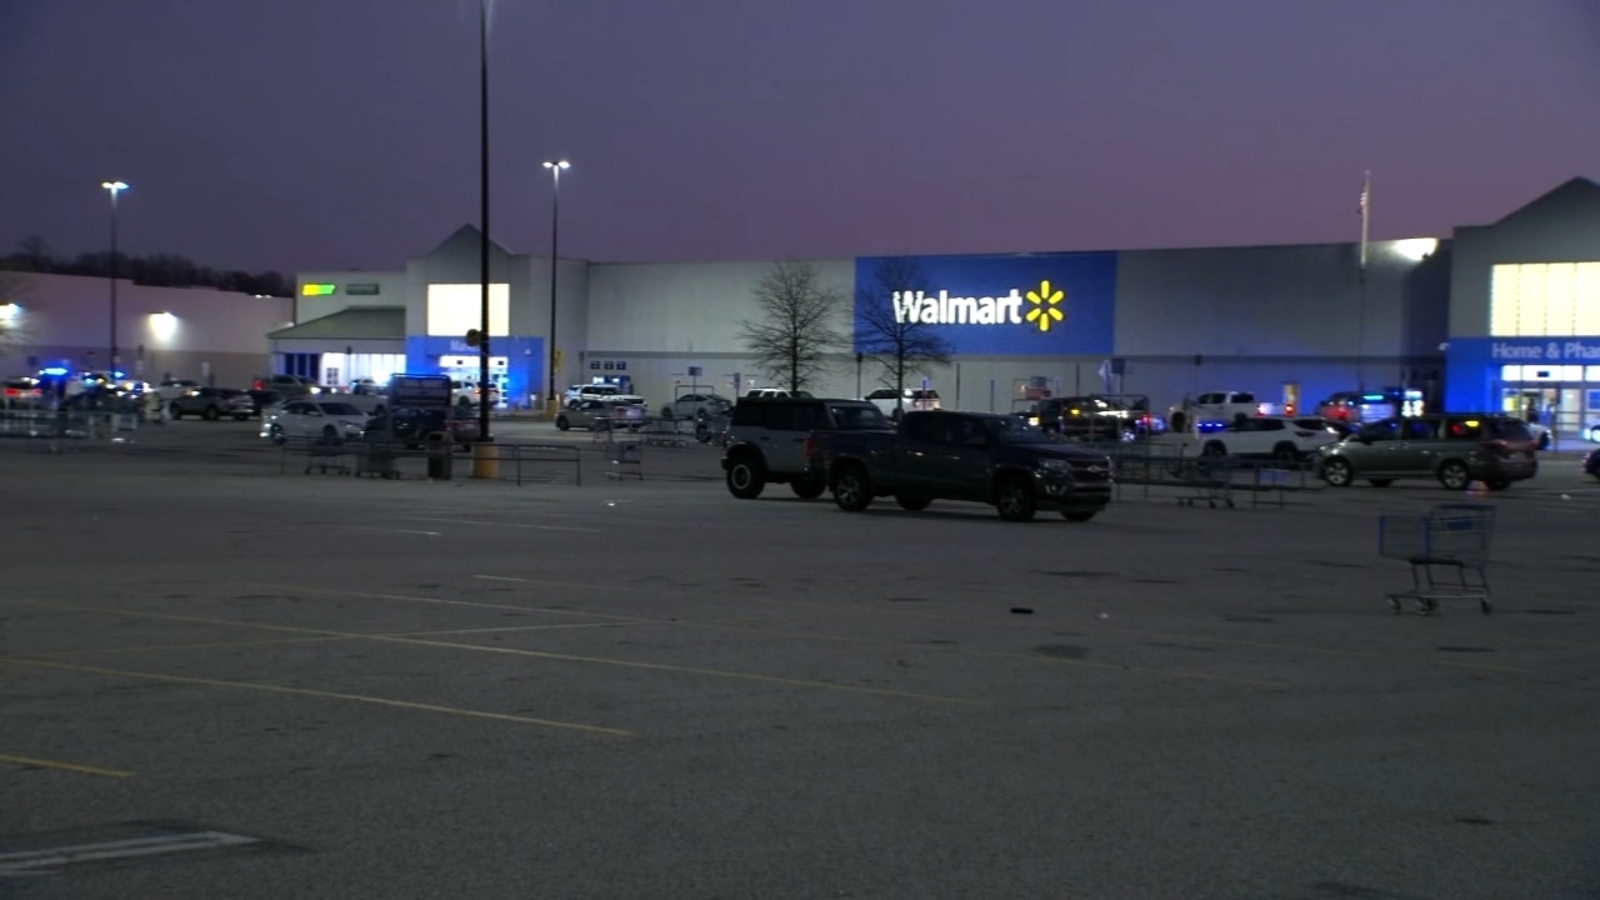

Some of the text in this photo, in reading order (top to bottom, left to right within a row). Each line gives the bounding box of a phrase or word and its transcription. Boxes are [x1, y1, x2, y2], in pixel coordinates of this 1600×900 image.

[892, 289, 1022, 324] Walmart
[1492, 342, 1541, 359] Home
[1546, 342, 1560, 359] &
